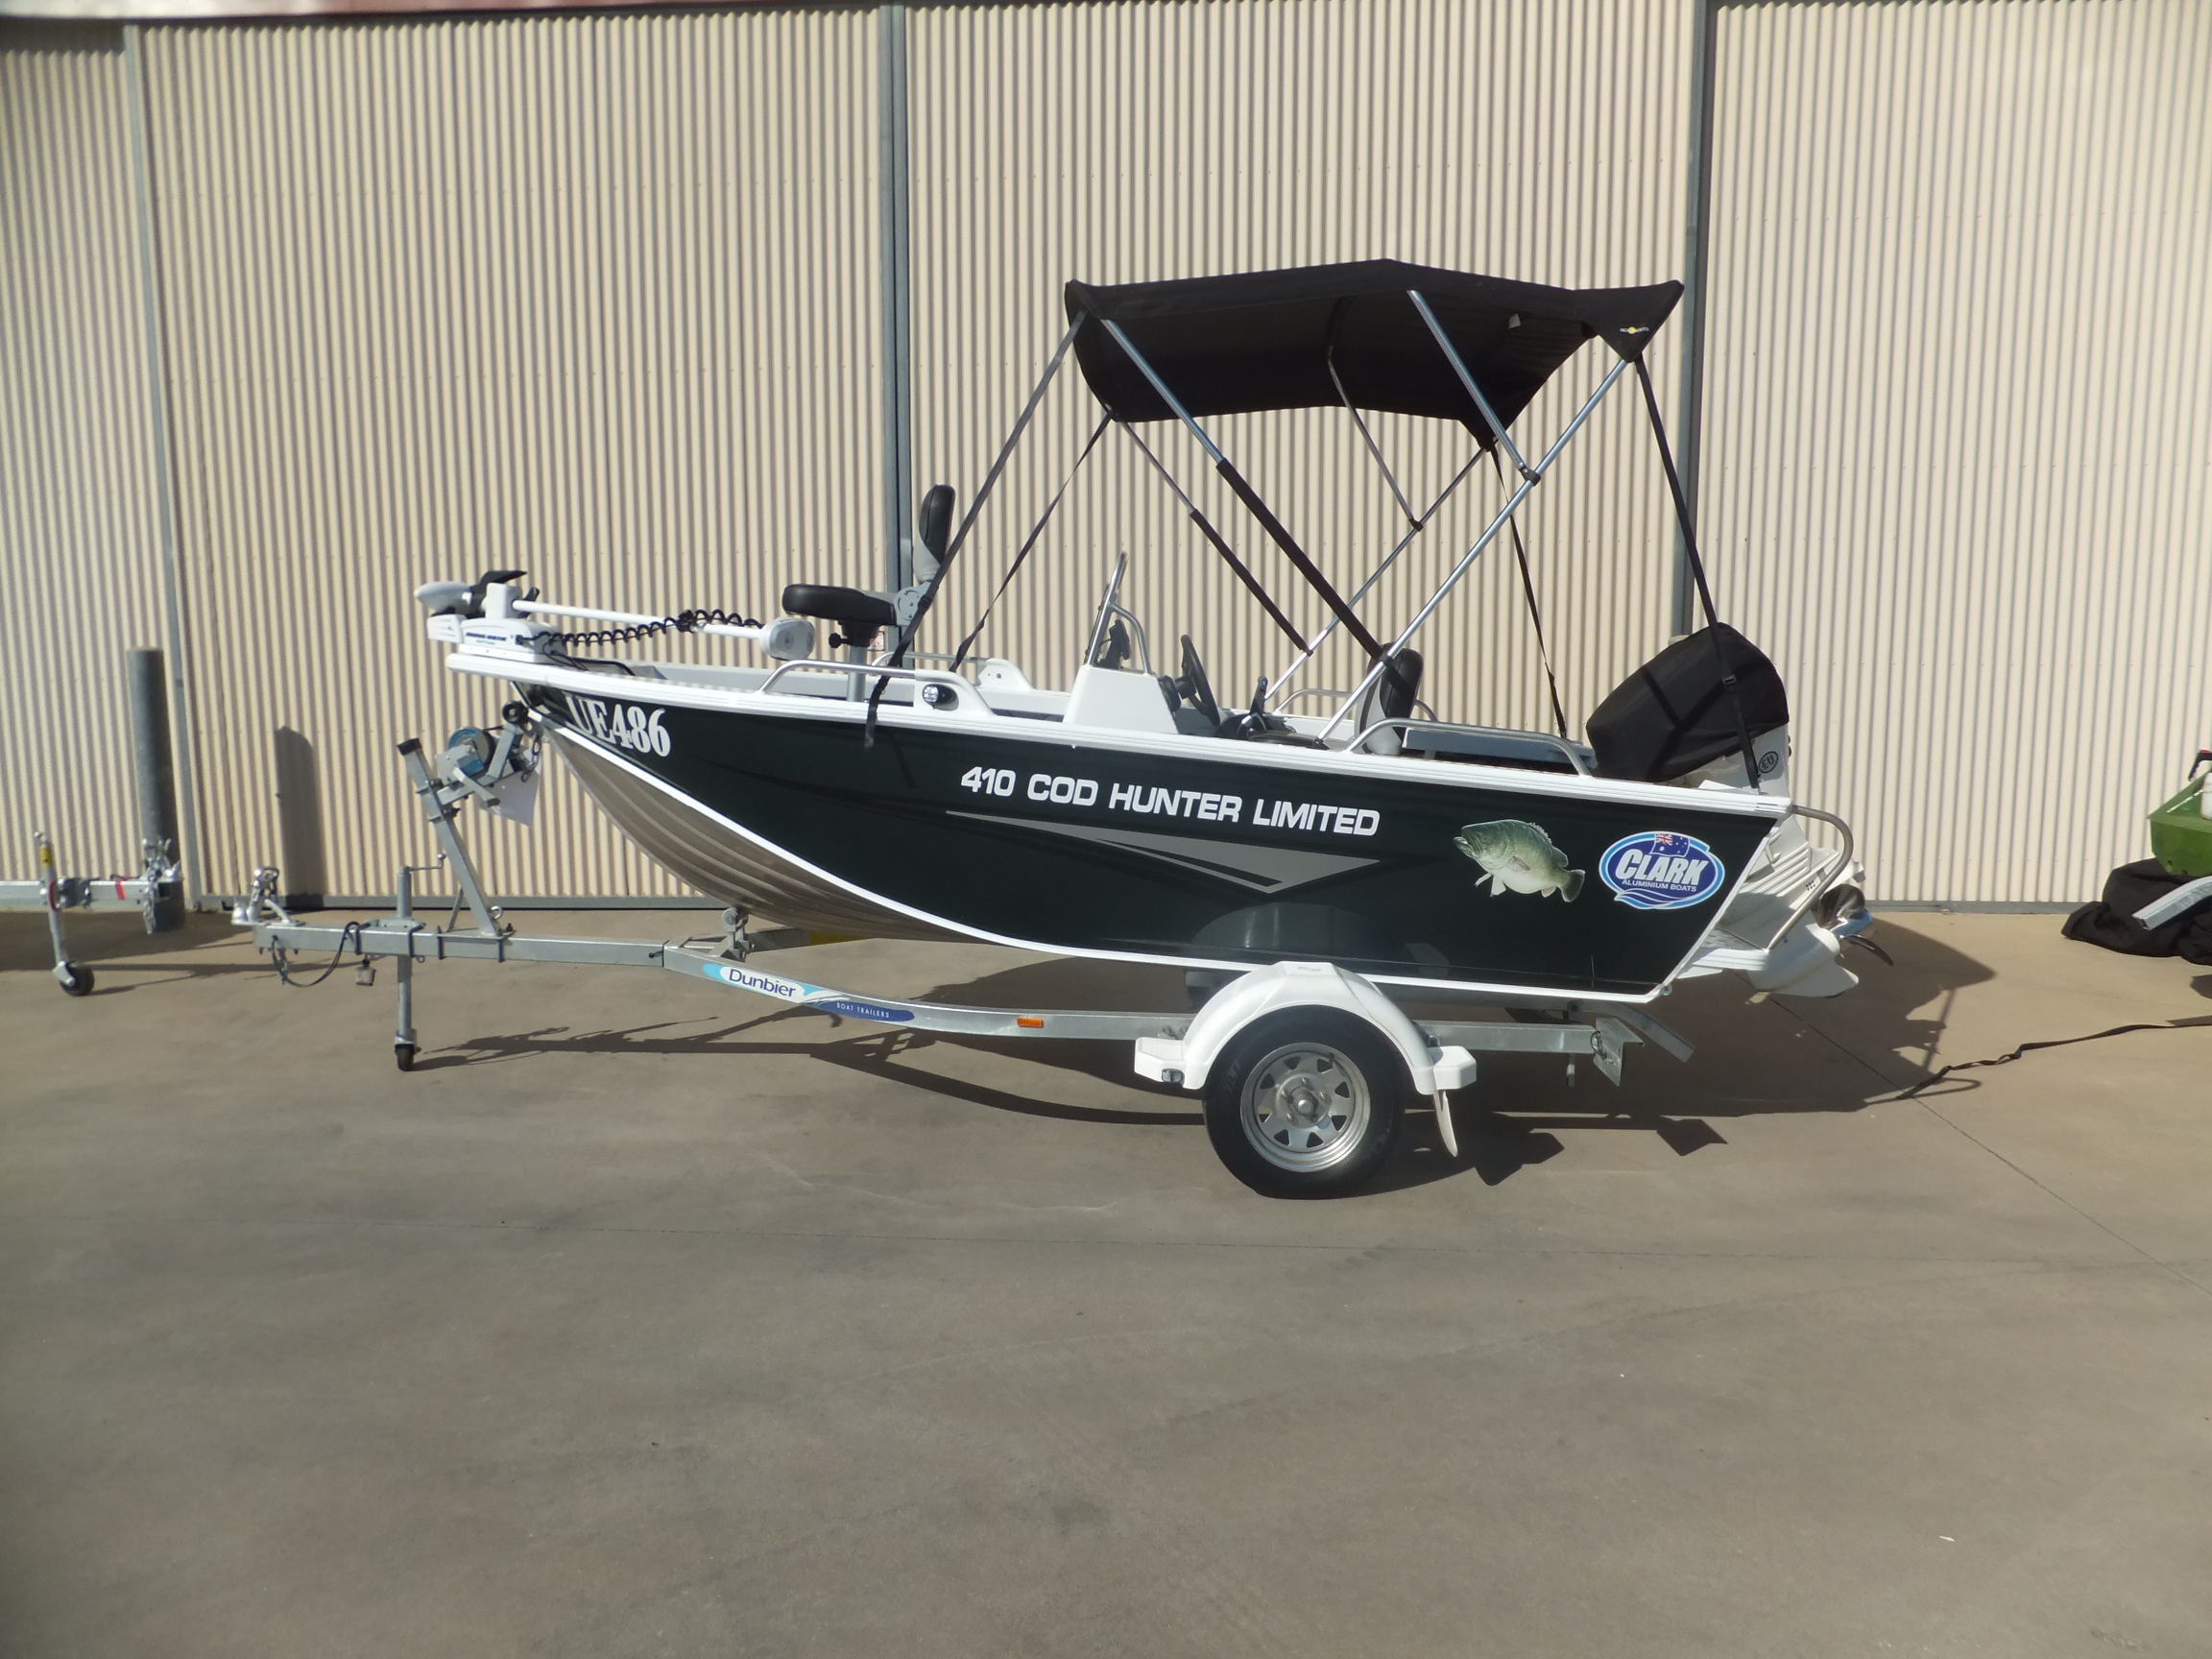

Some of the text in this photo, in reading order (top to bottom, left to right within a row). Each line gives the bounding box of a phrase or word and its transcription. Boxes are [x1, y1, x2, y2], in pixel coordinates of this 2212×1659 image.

[960, 766, 1381, 836] 410 COD HUNTER LIMITED
[1615, 849, 1710, 886] CLARK
[1622, 878, 1697, 893] ALUMINIUM BOATS
[728, 968, 796, 998] Dunbier
[836, 1001, 854, 1012] BOAT
